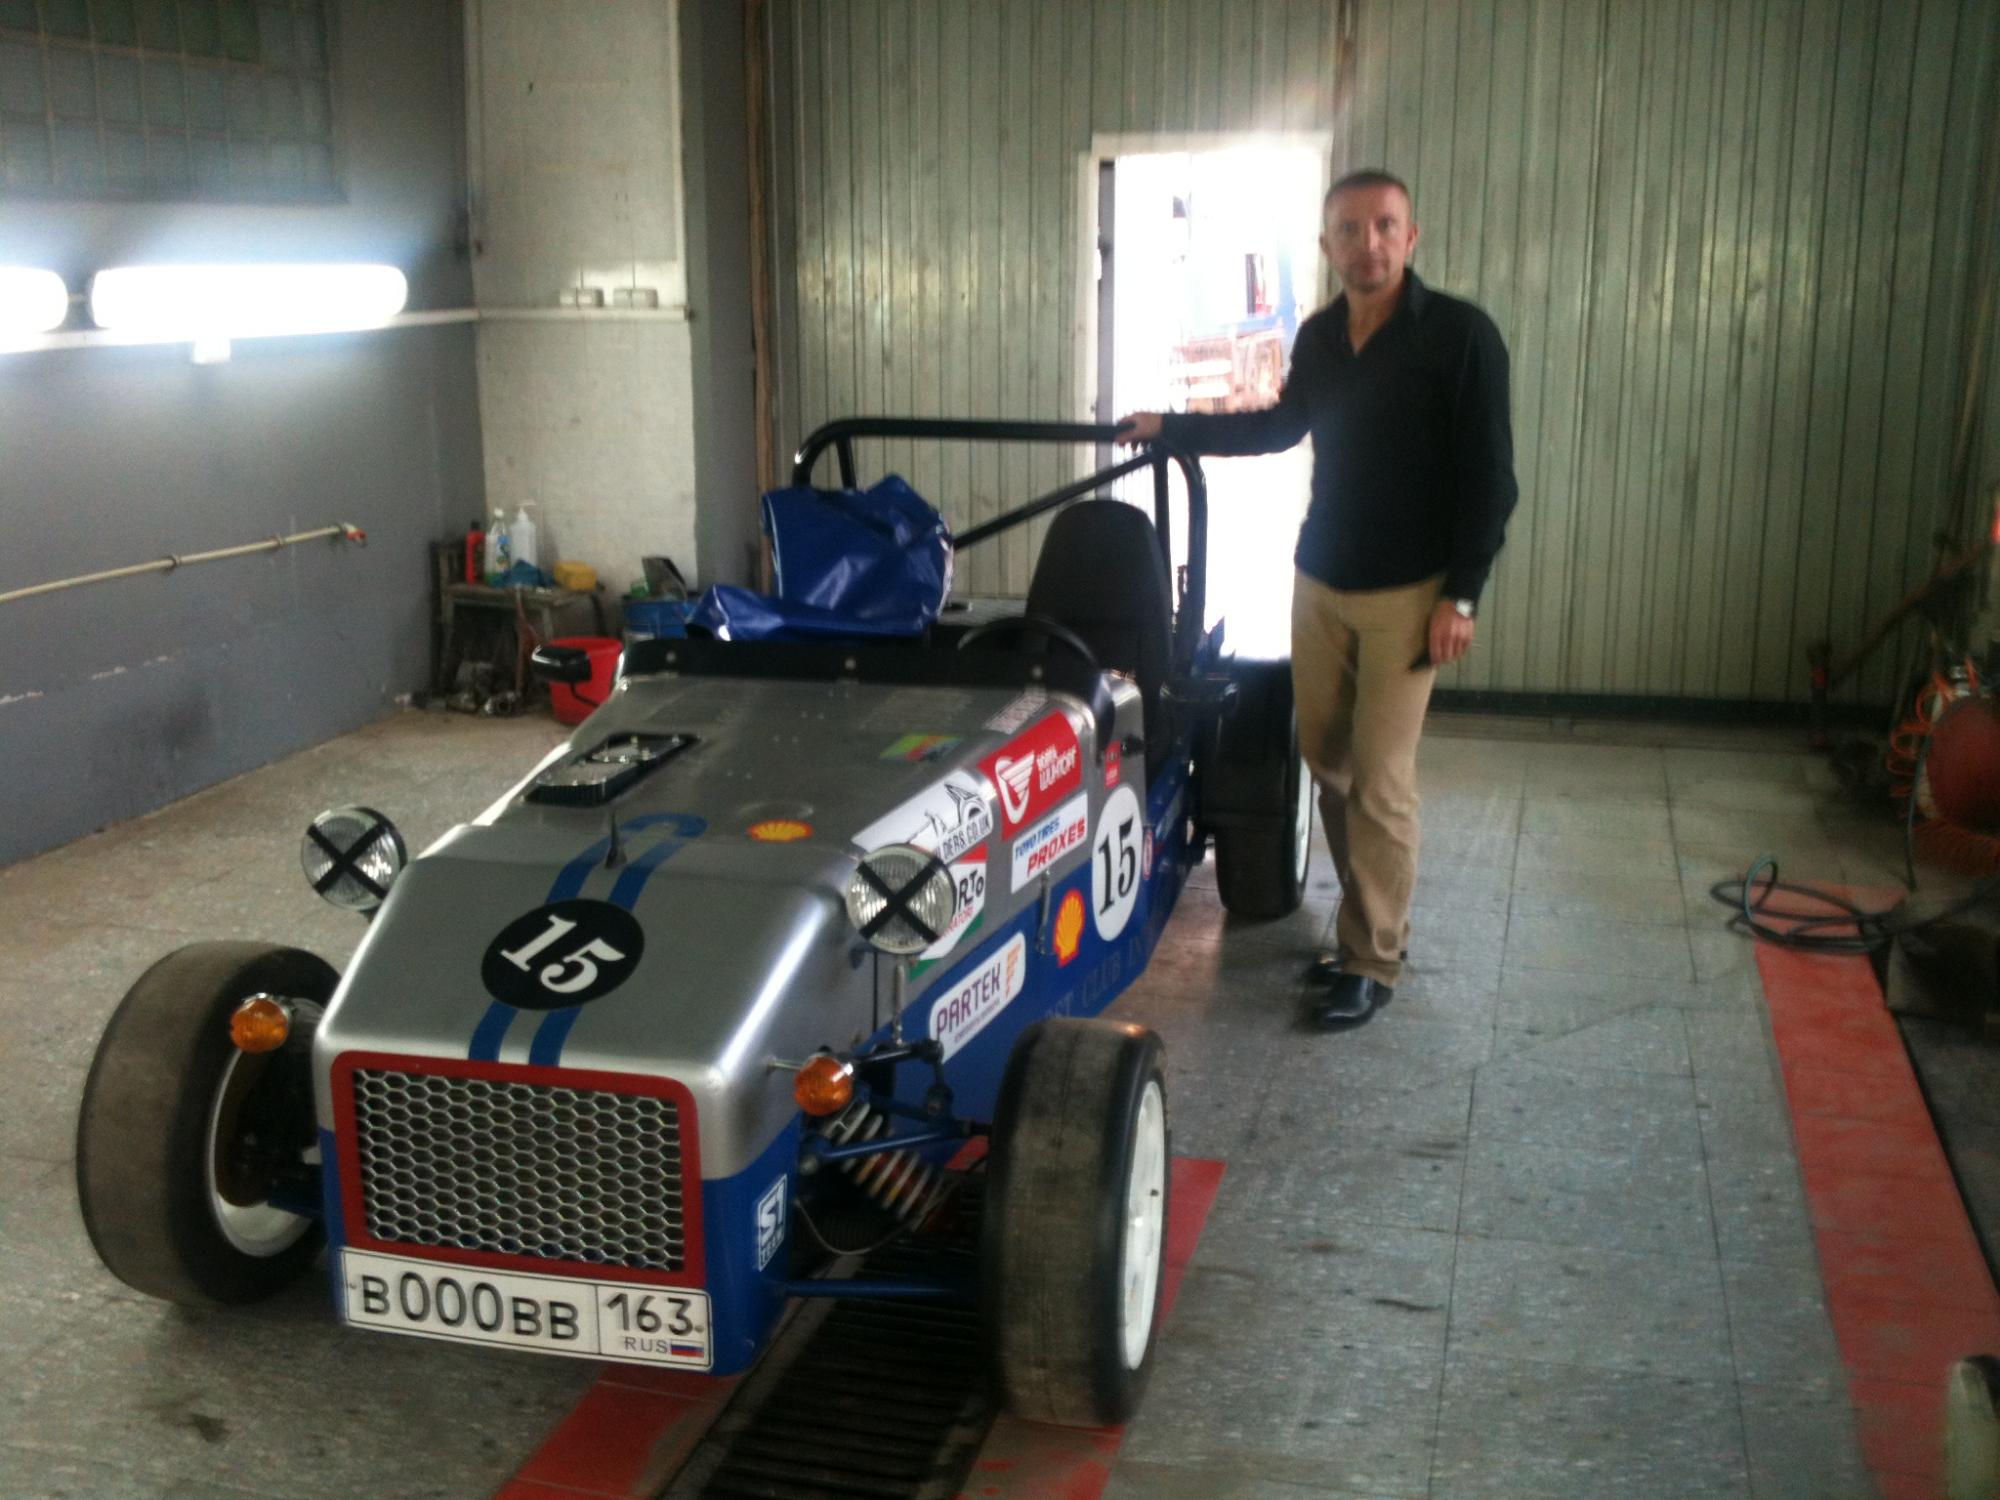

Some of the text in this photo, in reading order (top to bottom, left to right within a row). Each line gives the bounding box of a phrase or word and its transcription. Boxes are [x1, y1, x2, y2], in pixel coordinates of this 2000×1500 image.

[1027, 816, 1086, 879] PROXES
[1098, 815, 1135, 916] 15
[958, 869, 984, 911] RTO
[500, 914, 626, 993] 15
[937, 962, 1001, 1040] PARTEK
[607, 1292, 693, 1337] 163
[625, 1336, 668, 1354] RUS
